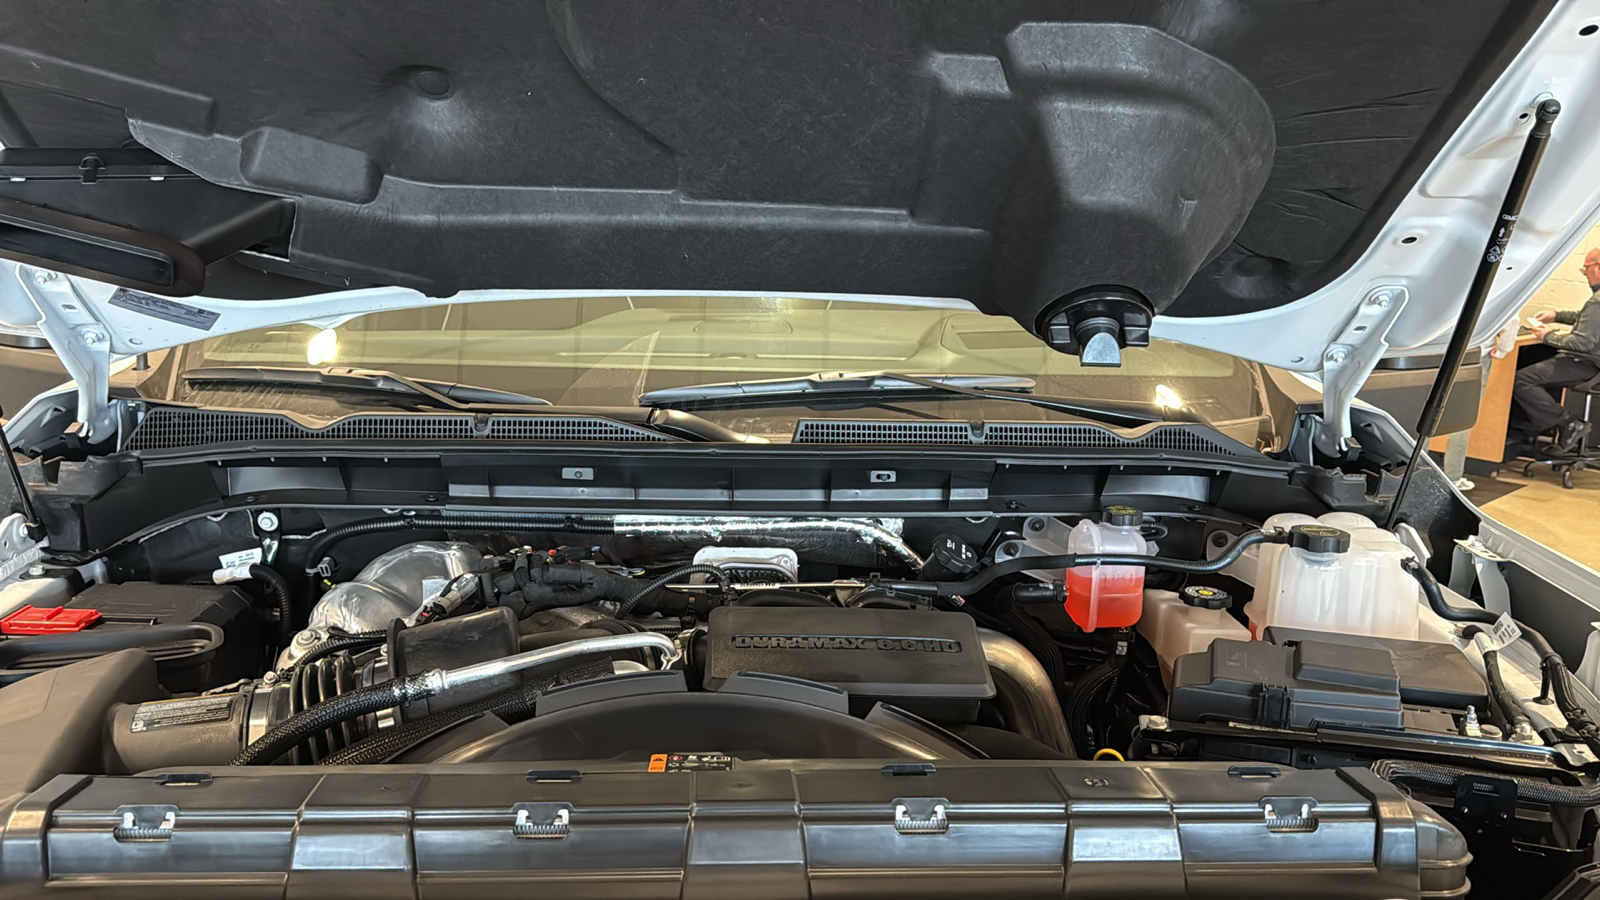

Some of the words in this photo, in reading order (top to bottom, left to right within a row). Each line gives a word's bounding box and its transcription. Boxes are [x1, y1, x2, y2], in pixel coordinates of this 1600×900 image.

[735, 636, 867, 650] DURAMAX
[877, 638, 916, 651] 6.6
[924, 640, 961, 653] HD
